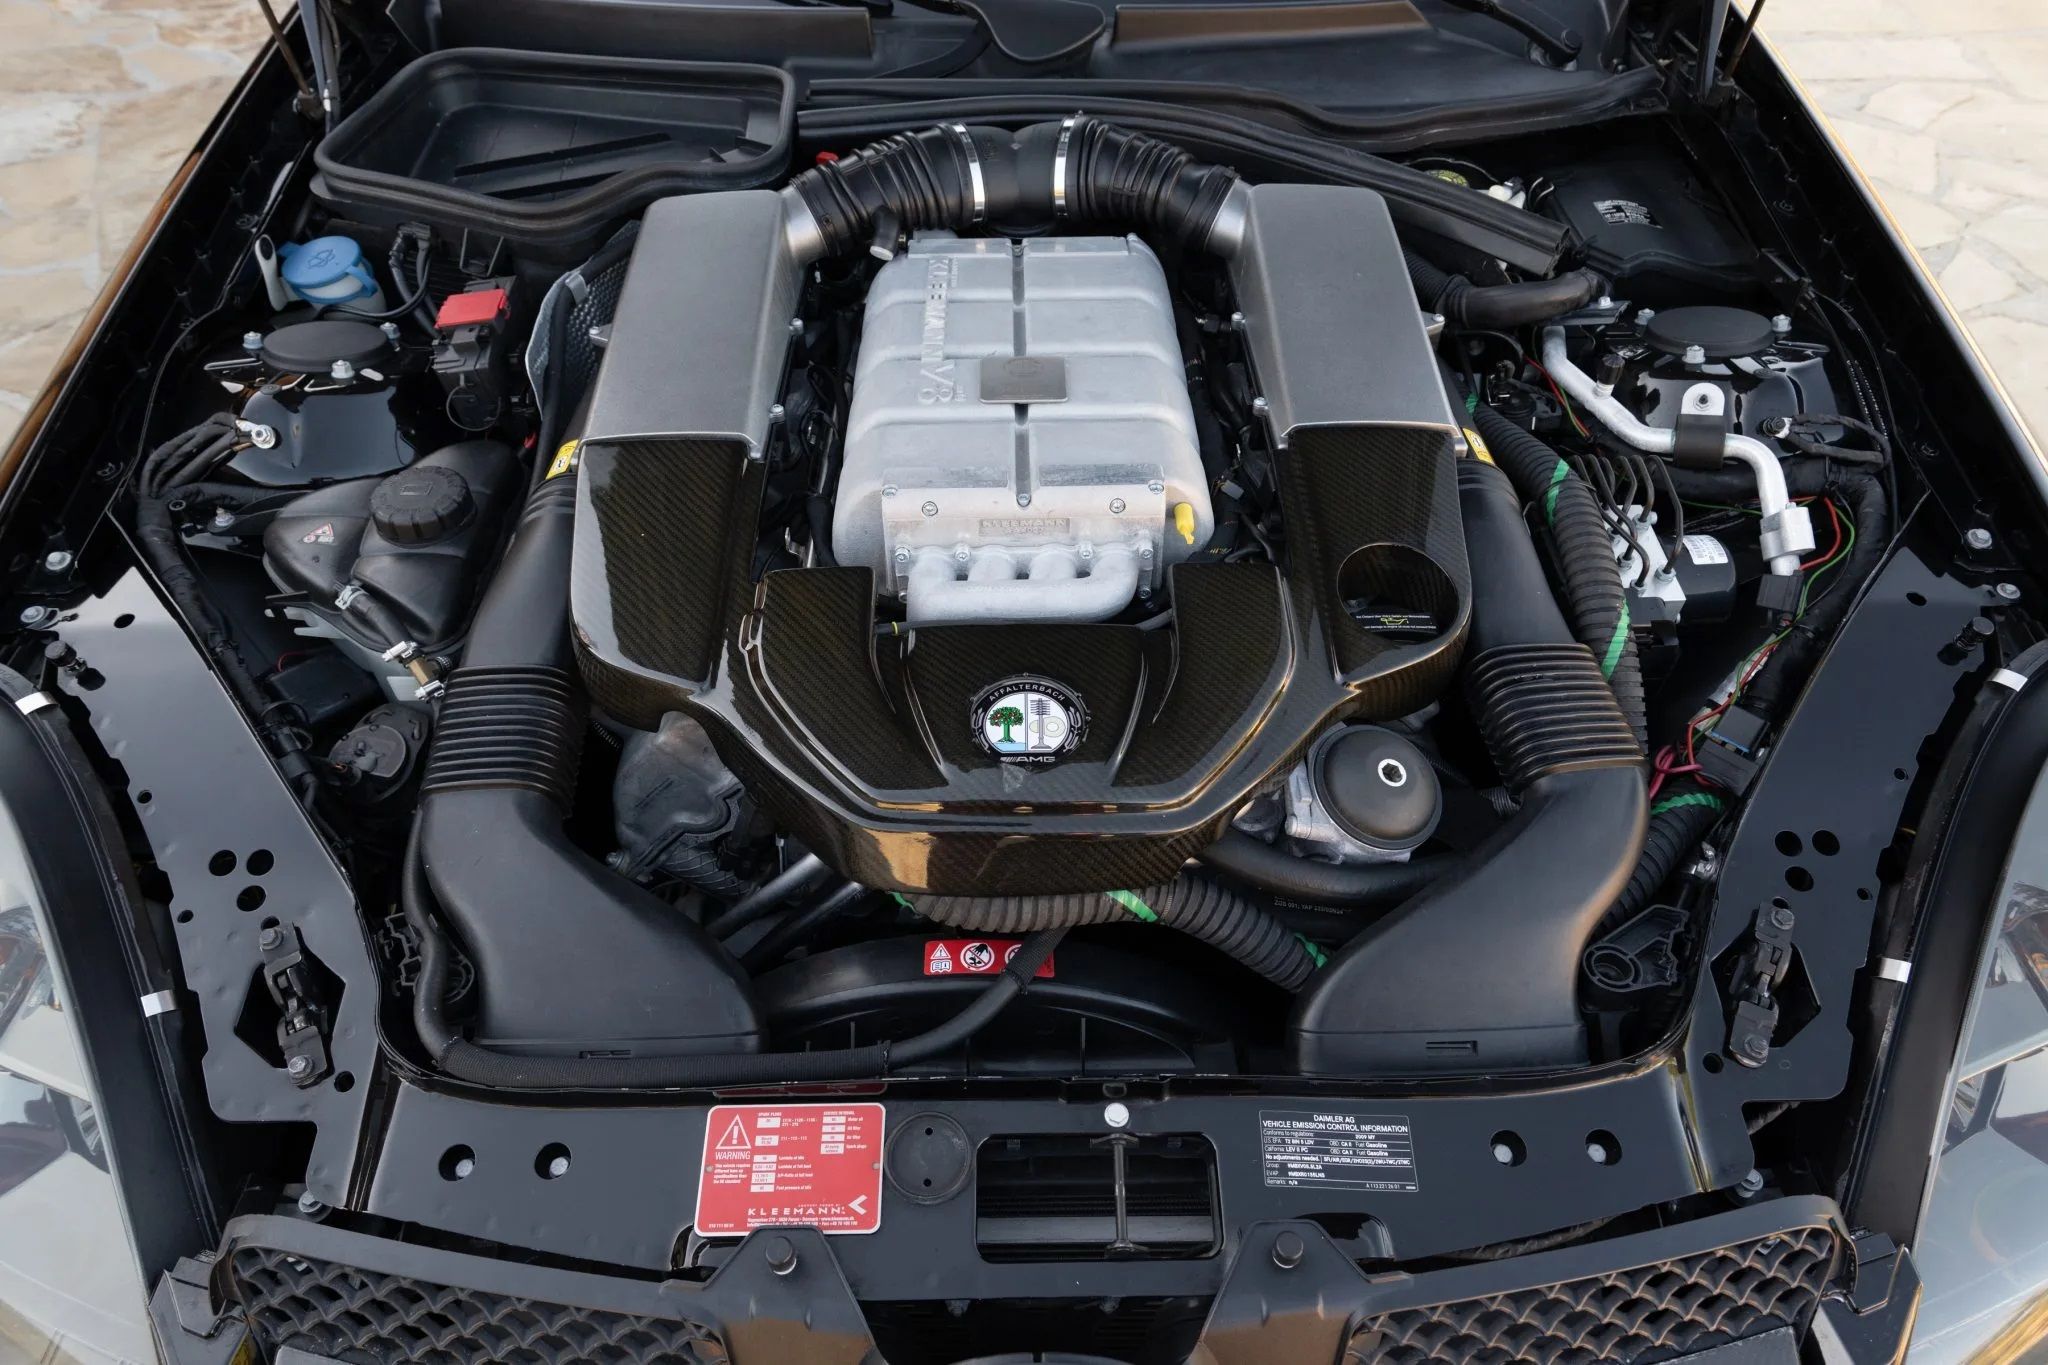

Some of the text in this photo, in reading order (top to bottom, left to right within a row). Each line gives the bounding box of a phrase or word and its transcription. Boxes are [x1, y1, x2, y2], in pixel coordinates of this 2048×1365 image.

[989, 684, 1066, 702] AFFALTERBACH
[1313, 1115, 1355, 1124] DAIMLER AG
[1262, 1120, 1408, 1133] VEHICLE EMISSION CONTROL INFORMATION
[715, 1151, 751, 1160] WARNING
[747, 1207, 841, 1216] KLEEMANN
